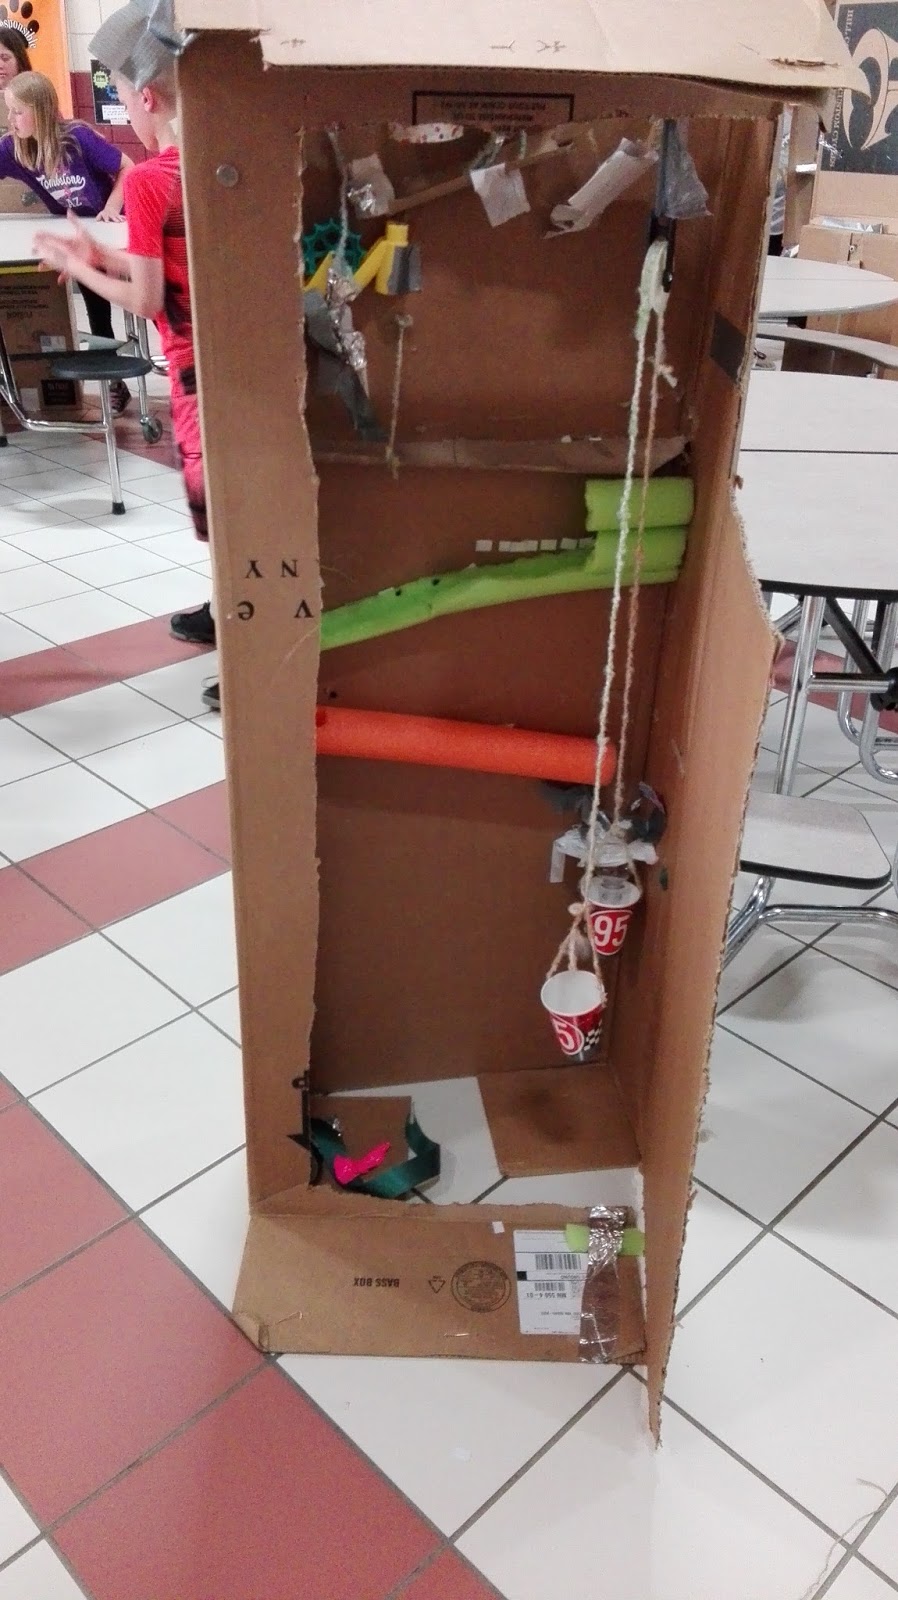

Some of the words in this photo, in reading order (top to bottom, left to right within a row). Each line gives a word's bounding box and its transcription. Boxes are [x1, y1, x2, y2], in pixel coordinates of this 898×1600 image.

[833, 87, 843, 129] CUSTOM
[35, 173, 86, 192] Tombstone
[67, 196, 83, 209] AZ
[594, 914, 631, 948] 95
[353, 1277, 373, 1287] BOX
[375, 1278, 400, 1288] BASS
